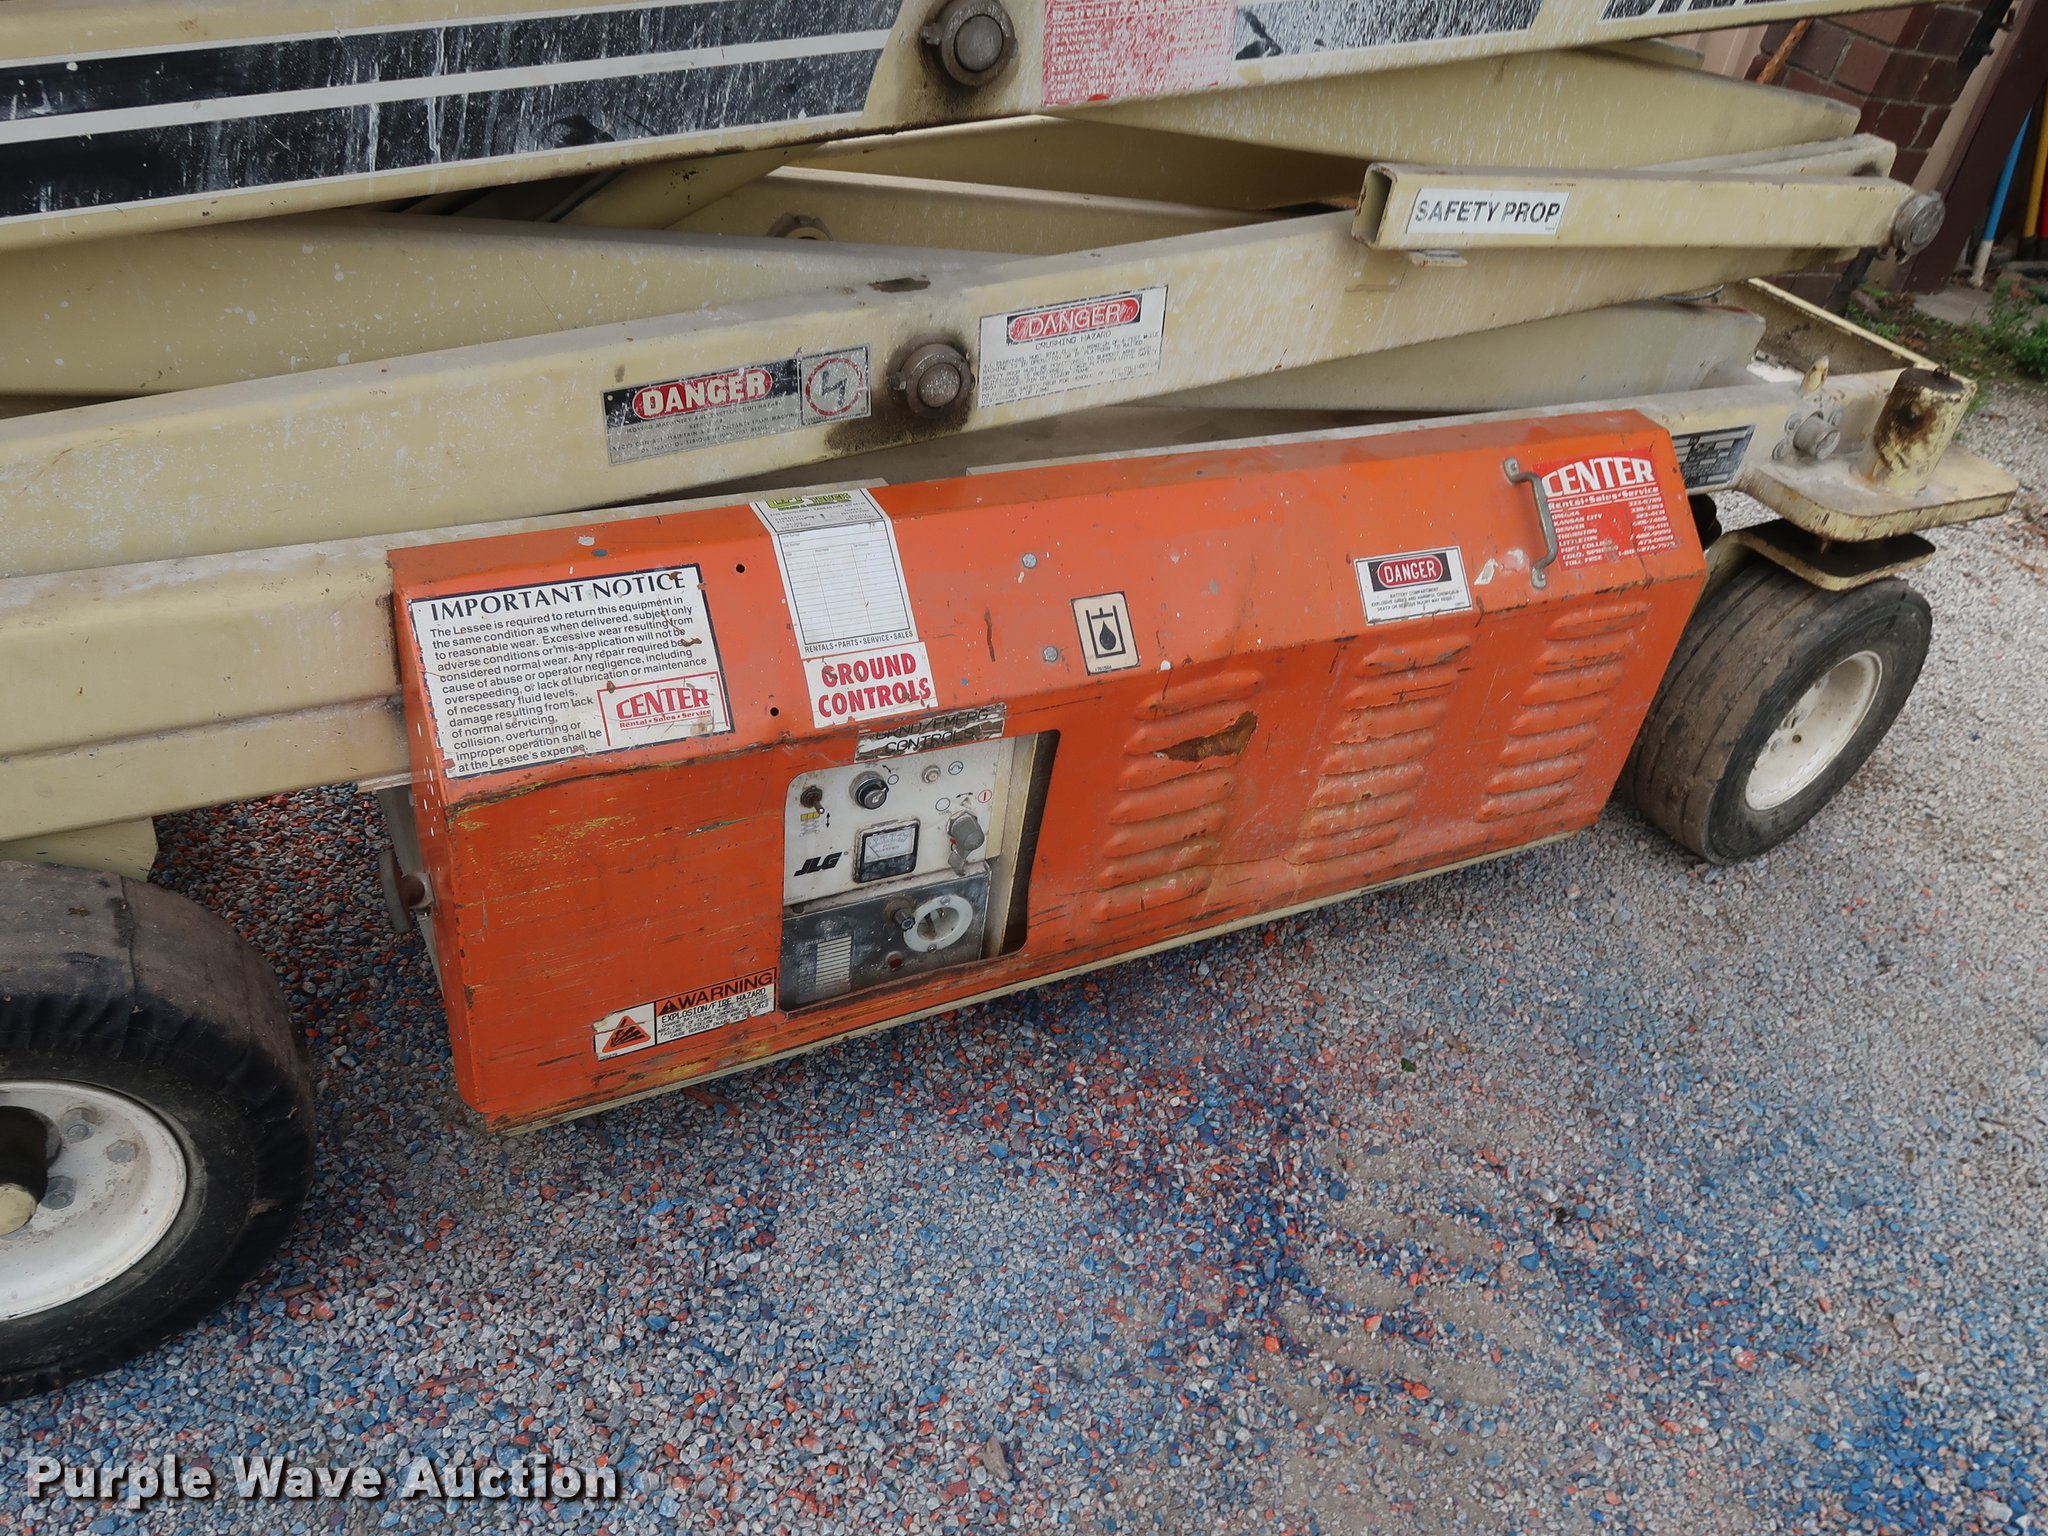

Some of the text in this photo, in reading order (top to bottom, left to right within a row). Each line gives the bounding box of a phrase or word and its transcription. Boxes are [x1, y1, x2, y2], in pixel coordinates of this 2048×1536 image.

[1415, 200, 1561, 223] SAFETY PROP
[1027, 302, 1120, 337] DANGER
[1035, 329, 1111, 350] CRUSHING HAZARD
[641, 370, 766, 417] DANGER
[1541, 457, 1655, 498] CENTER
[1547, 497, 1584, 509] Rental
[1588, 492, 1617, 503] Sales
[1621, 485, 1659, 498] Service
[1551, 510, 1580, 519] OMAHA
[1553, 516, 1584, 526] KANSAS
[1555, 523, 1585, 532] DENVER
[1557, 528, 1597, 539] THORNTON
[1558, 535, 1598, 545] LITTLETON
[1560, 545, 1580, 553] FORT
[1383, 559, 1436, 583] DANGER
[430, 571, 685, 620] IMPORTANT NOTICE
[429, 595, 683, 637] The Lessee is required to return this equipment in
[432, 605, 693, 649] the same condition as when delivered, subject only
[434, 615, 693, 659] to reasonable wear. Excessive wear resulting from
[436, 657, 481, 671] adverse
[482, 648, 540, 664] conditions
[554, 635, 635, 655] mis-application
[635, 632, 653, 642] will
[655, 629, 671, 639] not
[673, 627, 685, 636] be
[804, 630, 914, 653] RENTALS PARTS SERVICE SALES
[439, 665, 501, 682] considered
[502, 659, 541, 672] normal
[542, 657, 570, 666] wear.
[572, 652, 593, 664] Any
[594, 647, 625, 660] repair
[626, 640, 669, 655] required
[441, 682, 475, 693] cause
[476, 678, 488, 688] of
[489, 673, 522, 686] abuse
[537, 664, 584, 680] operator
[584, 655, 644, 673] negligence,
[645, 648, 693, 664] including
[821, 652, 917, 688] GROUND
[443, 685, 522, 706] overspeeding,
[536, 679, 559, 690] lack
[560, 677, 572, 686] of
[573, 669, 629, 684] lubrication
[630, 668, 641, 676] or
[643, 657, 707, 674] maintenance
[446, 688, 578, 715] of necessary fluid levels,
[448, 696, 593, 728] damage resulting from lack
[616, 687, 710, 720] CENTER
[818, 677, 932, 718] CONTROLS
[450, 728, 463, 738] of
[464, 722, 503, 736] normal
[619, 708, 711, 728] Rental Sales Service
[453, 733, 504, 750] collision,
[504, 723, 568, 742] overturning
[455, 729, 602, 762] improper operation shall be
[885, 729, 975, 753] CONTROLS
[457, 762, 469, 772] at
[470, 759, 488, 770] the
[793, 851, 843, 877] JLG
[677, 971, 772, 1010] WARNING
[661, 987, 765, 1024] EXPLOSION/FIRE HAZARD
